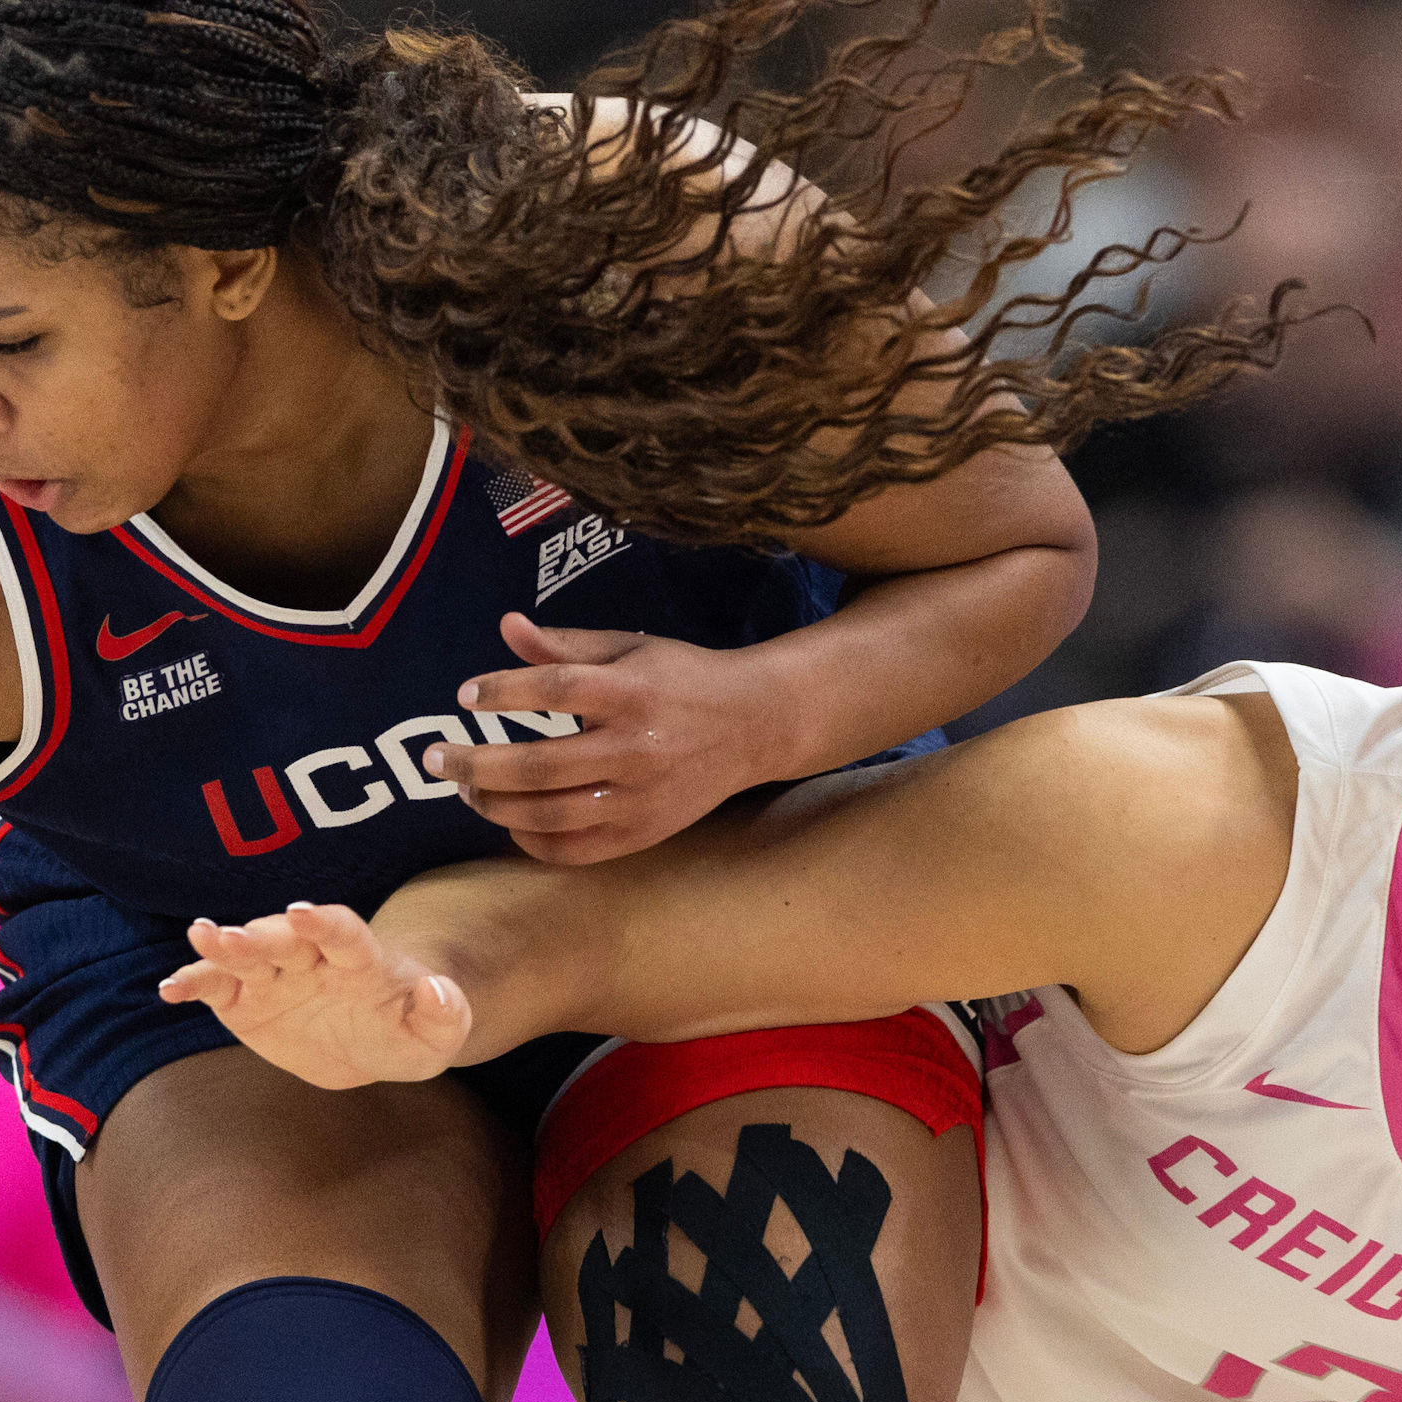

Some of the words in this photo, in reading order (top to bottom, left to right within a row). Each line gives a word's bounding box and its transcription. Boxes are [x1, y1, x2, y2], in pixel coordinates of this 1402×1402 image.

[537, 519, 631, 591] EAST
[539, 513, 603, 567] BIG
[122, 672, 157, 702] BE
[160, 652, 210, 689] THE
[122, 673, 222, 721] CHANGE
